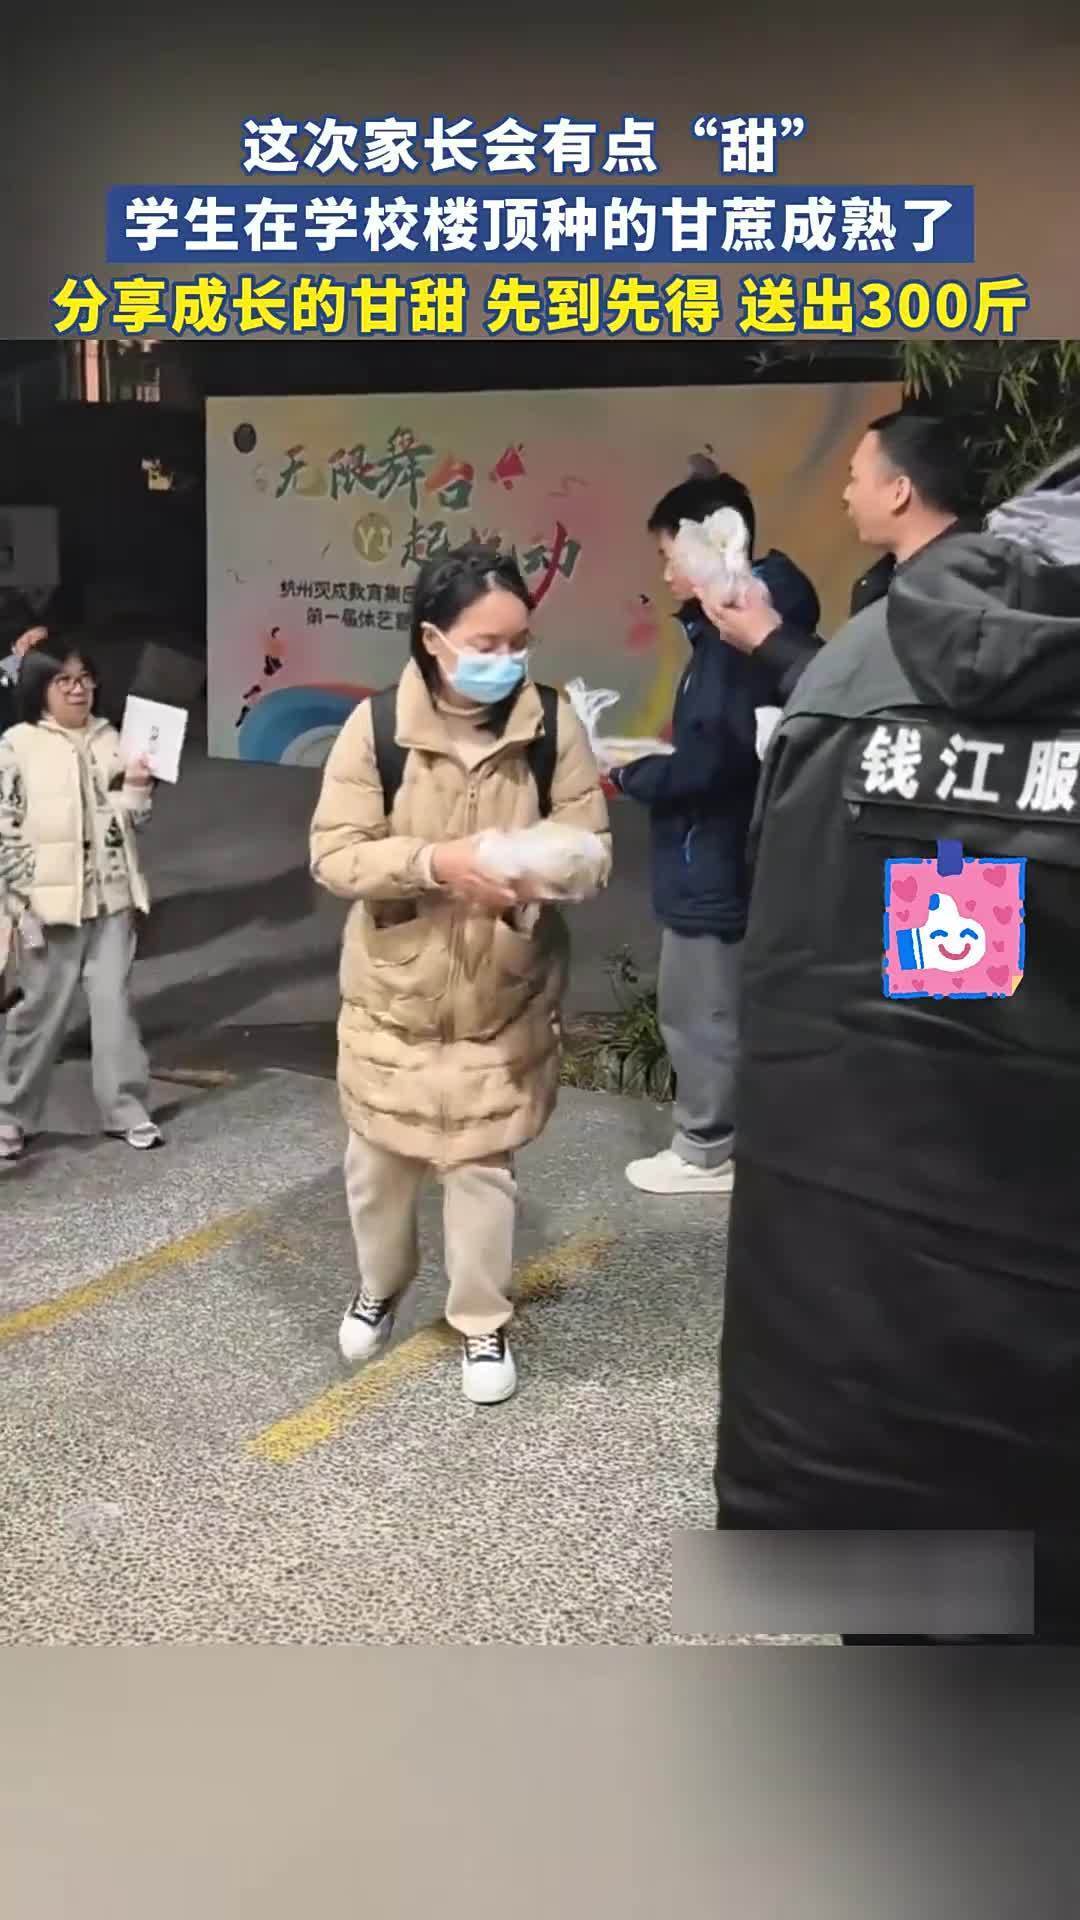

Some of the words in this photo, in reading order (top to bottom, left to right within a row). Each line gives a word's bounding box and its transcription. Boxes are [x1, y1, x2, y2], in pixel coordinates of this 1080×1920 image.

[275, 424, 474, 510] 无限舞台
[860, 724, 1080, 812] 钱江服
